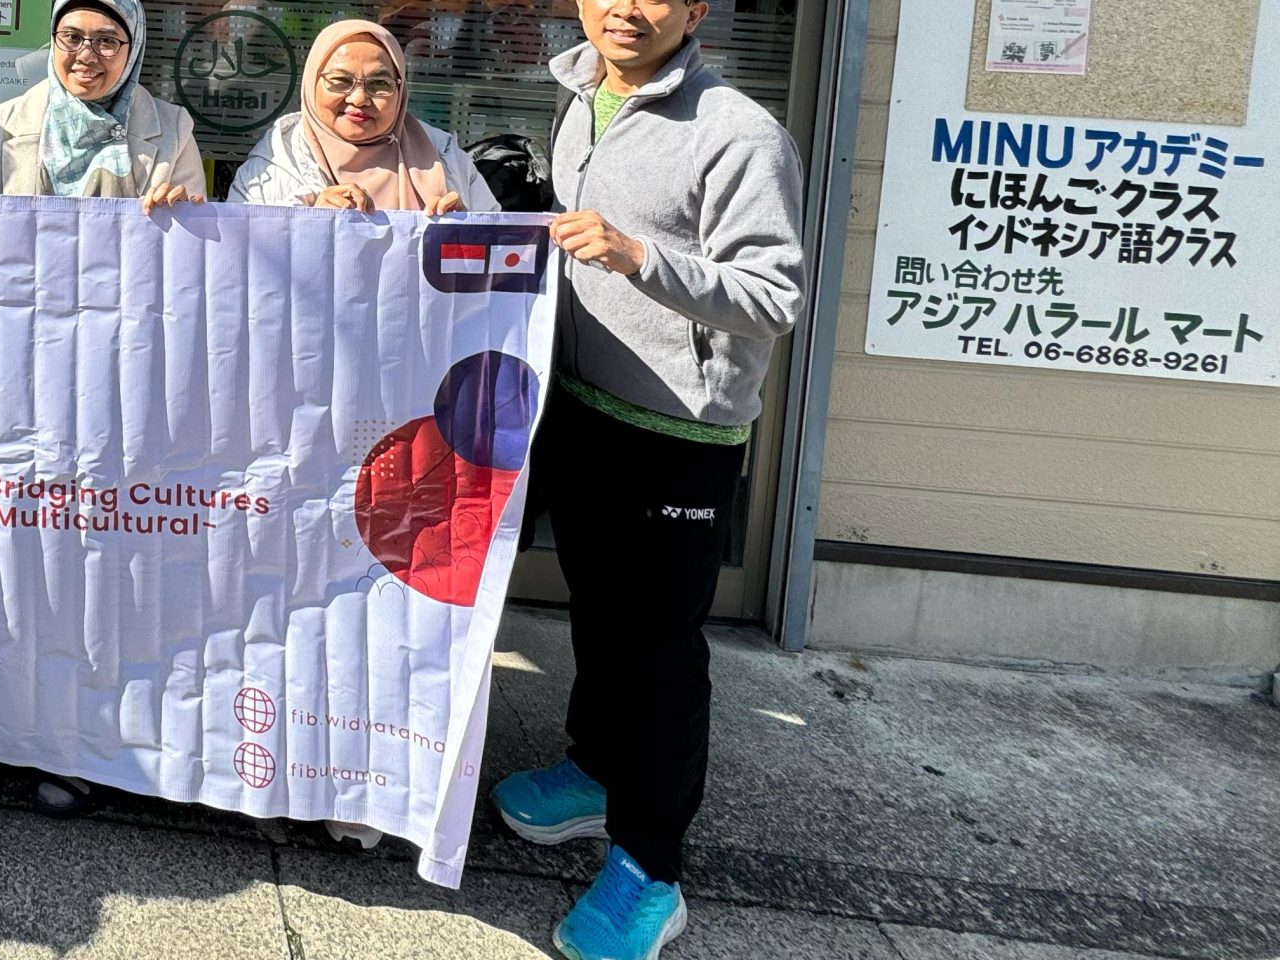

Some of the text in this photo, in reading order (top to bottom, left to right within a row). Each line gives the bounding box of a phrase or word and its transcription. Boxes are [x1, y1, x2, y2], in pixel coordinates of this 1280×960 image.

[201, 88, 267, 110] Halal
[931, 119, 1076, 169] MINU
[1084, 129, 1265, 180] アカデミー
[948, 214, 1238, 270] インドネシア語クラス
[895, 256, 1065, 296] 問い合わせ先
[885, 290, 1265, 354] アジア ハラール マート
[1023, 341, 1229, 374] 06-6868-9261
[128, 482, 271, 515] Cultures
[683, 507, 716, 520] YONEX
[291, 709, 446, 754] fib.widyatama
[290, 762, 388, 788] fibutama
